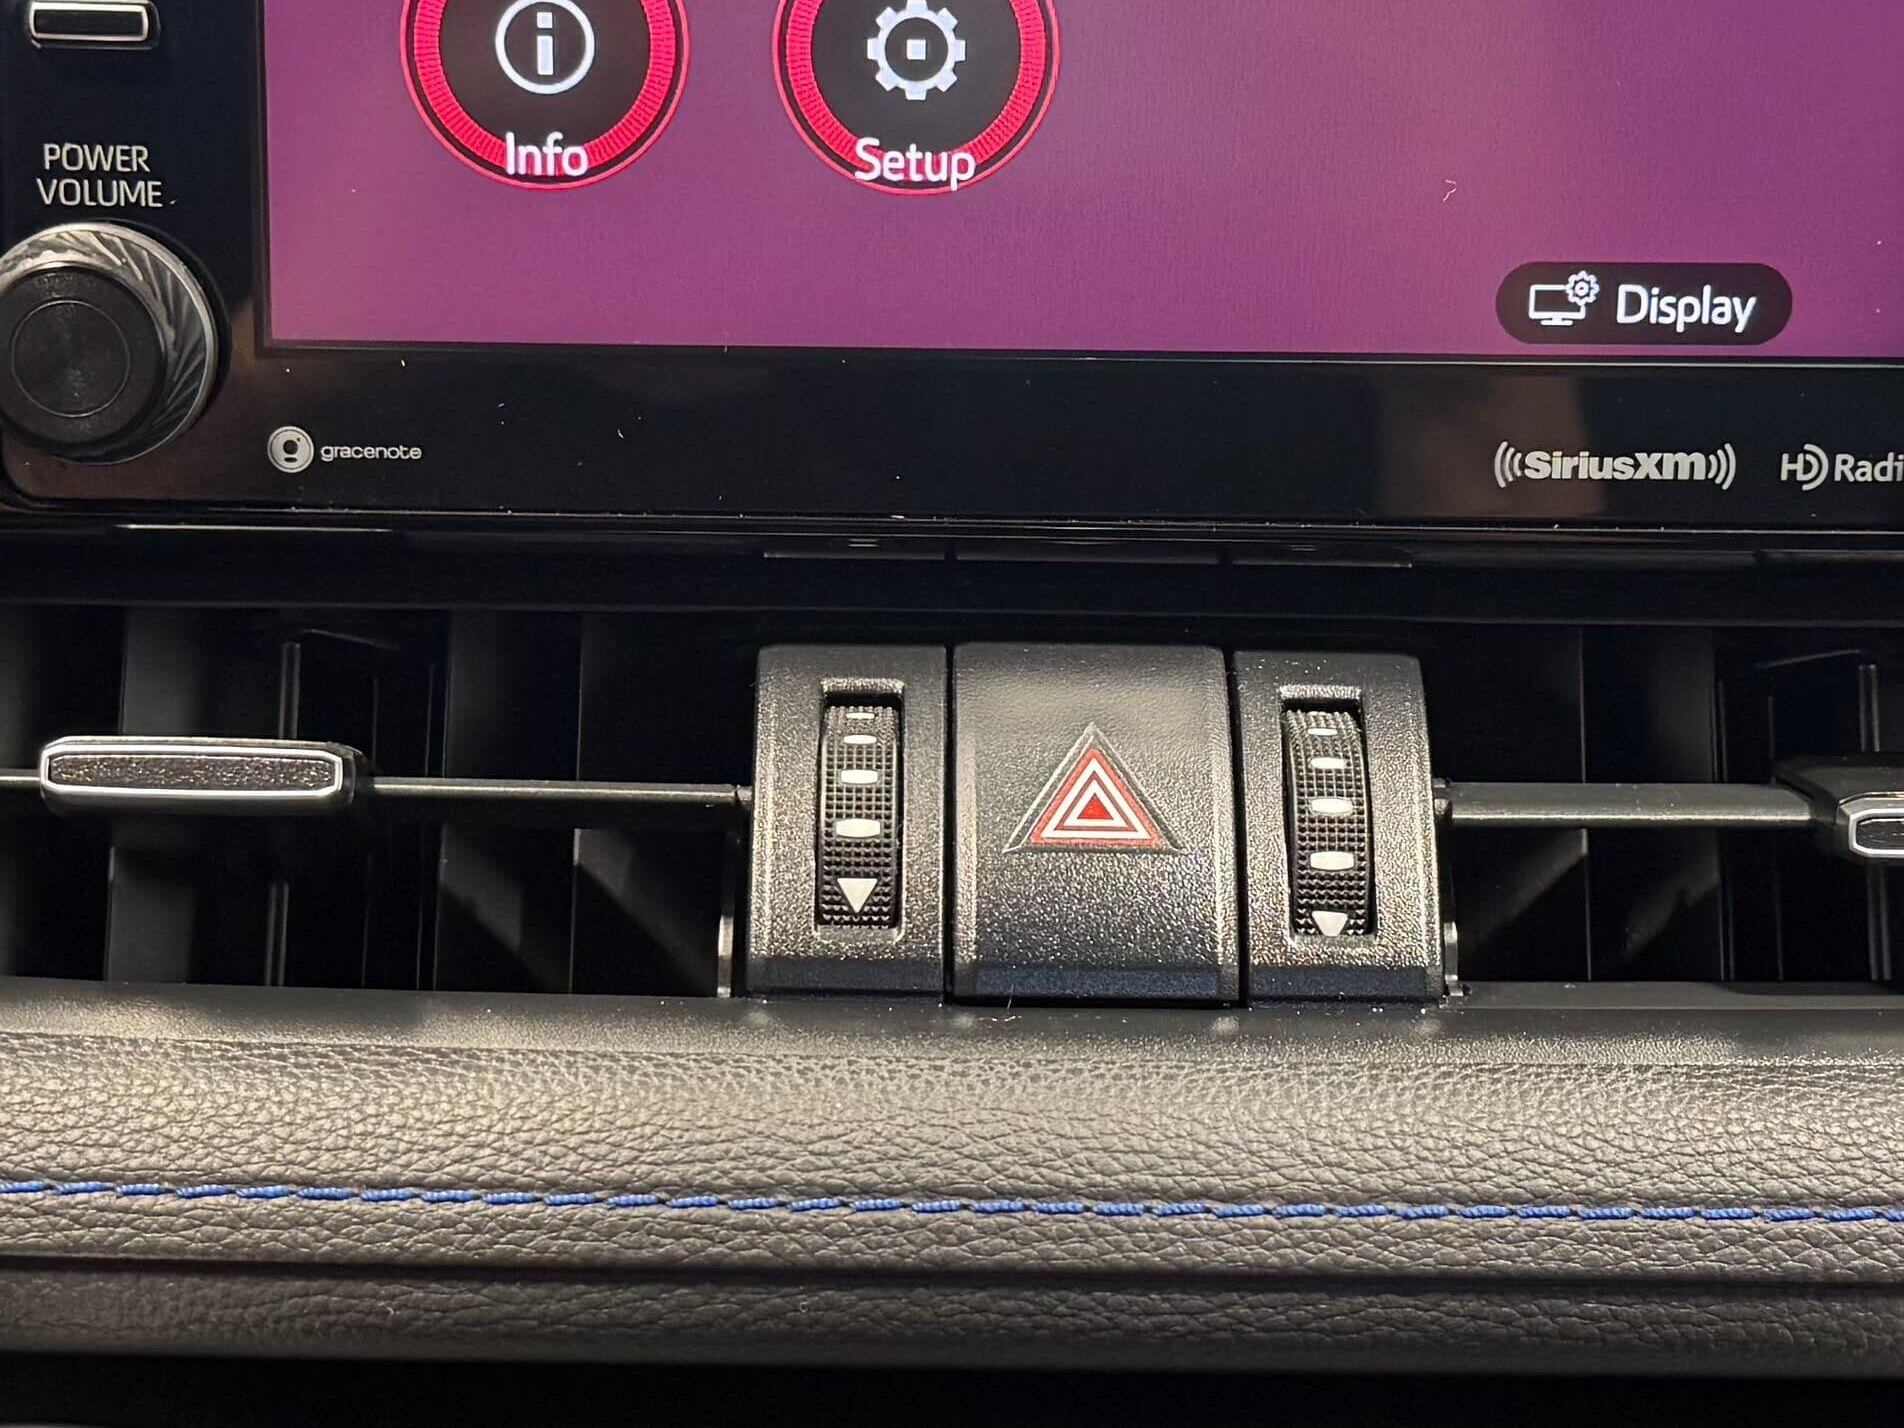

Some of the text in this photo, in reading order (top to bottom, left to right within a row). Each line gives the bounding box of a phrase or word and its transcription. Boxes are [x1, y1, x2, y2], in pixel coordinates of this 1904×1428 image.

[42, 142, 149, 175] POWER
[504, 131, 590, 178] Info
[853, 136, 977, 192] Setup
[36, 178, 164, 209] VOLUME
[1615, 282, 1759, 335] Display
[319, 444, 423, 463] gracenote
